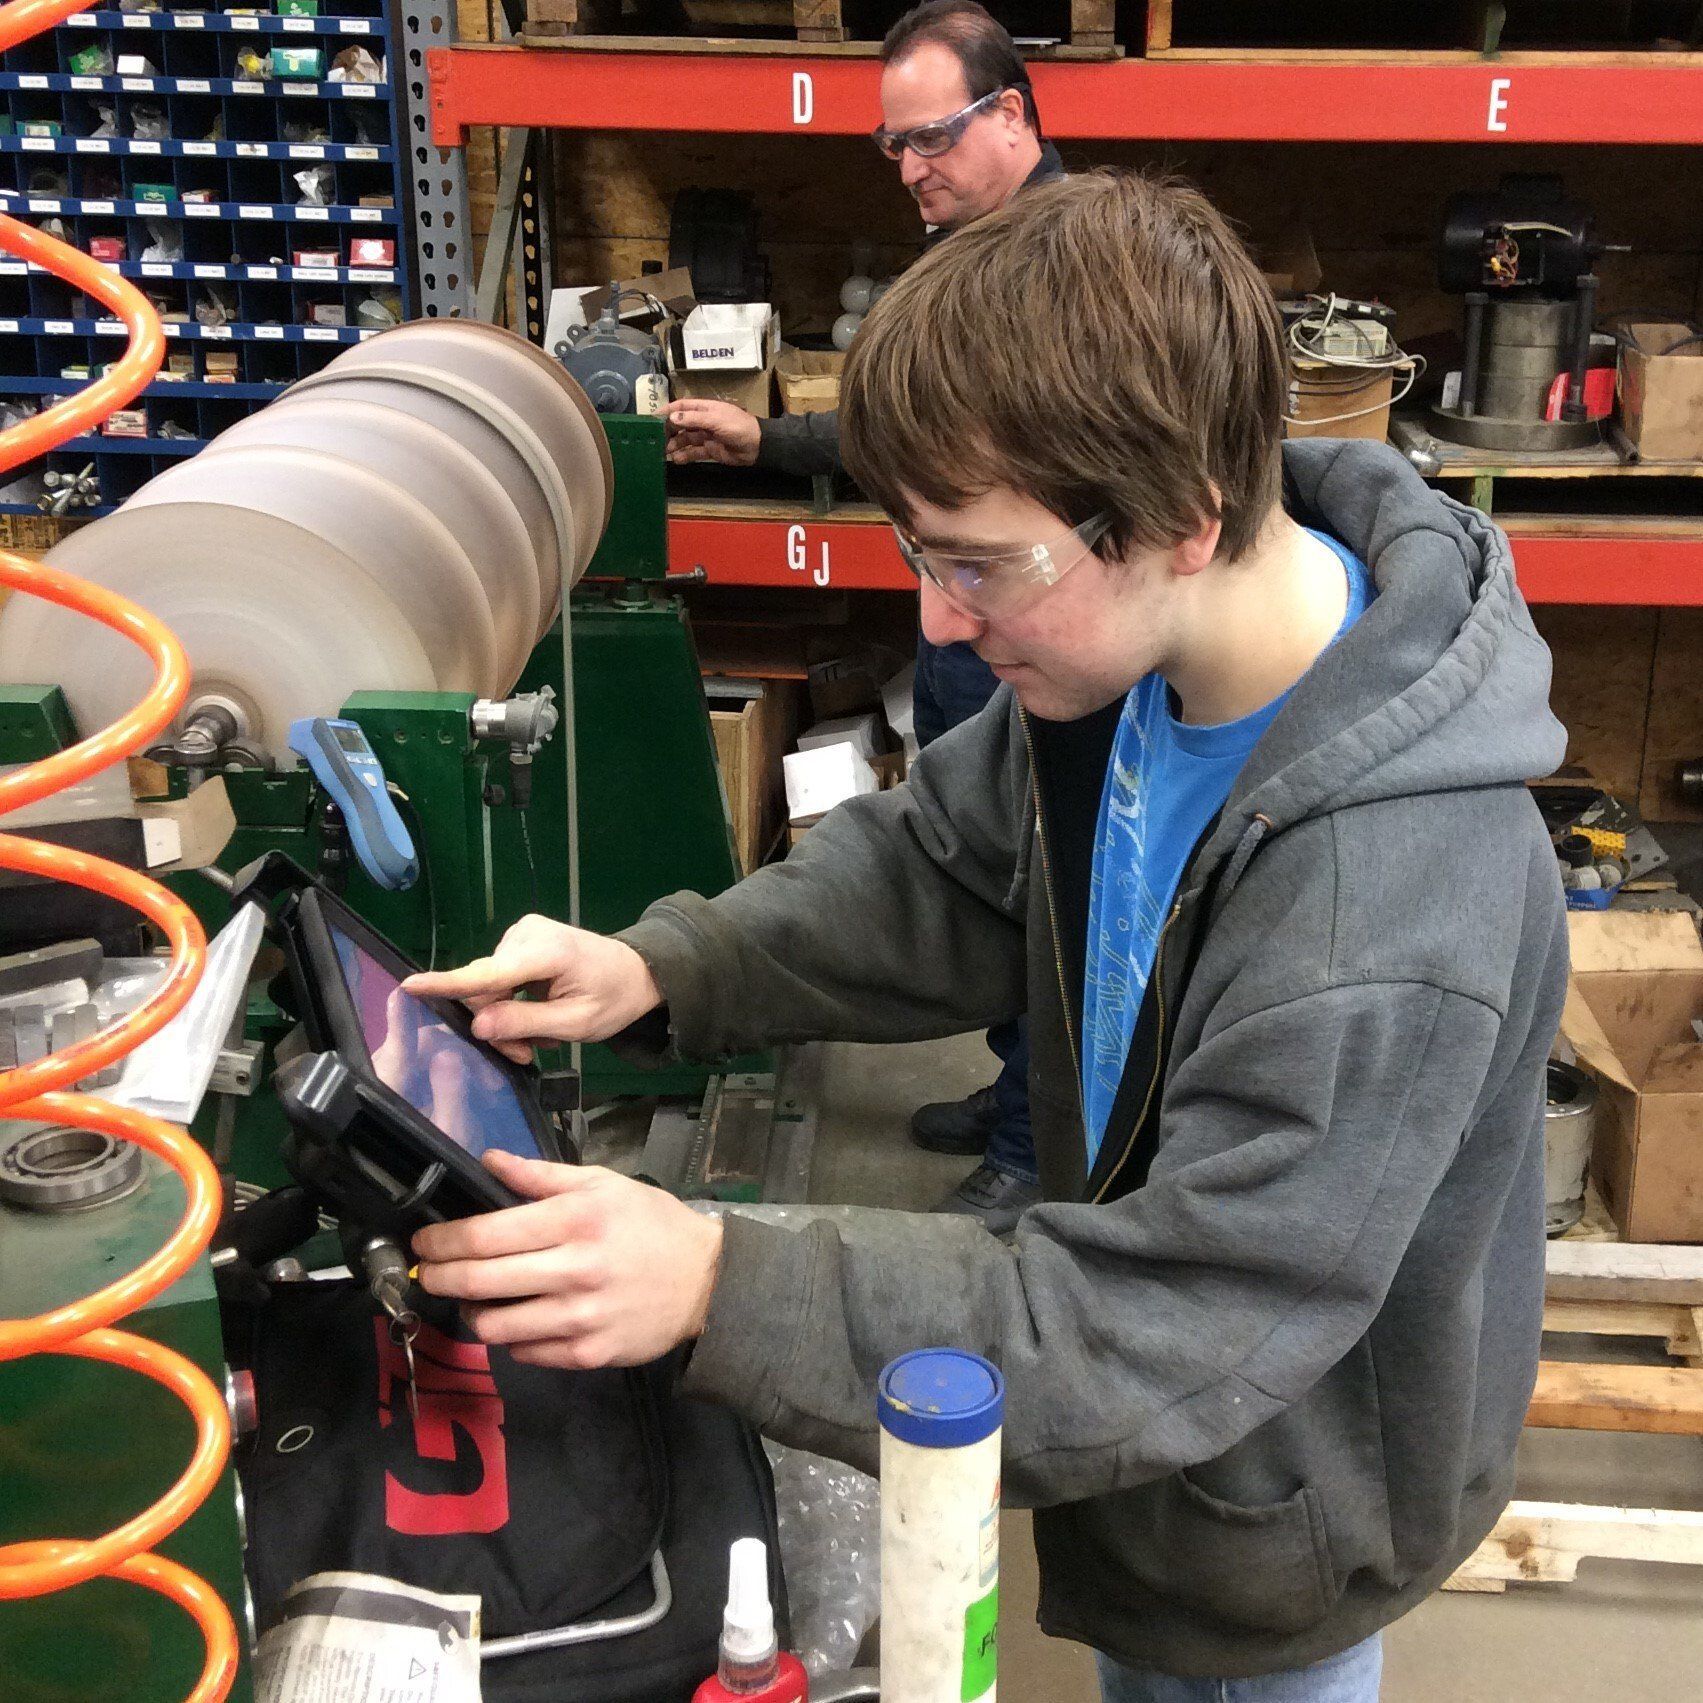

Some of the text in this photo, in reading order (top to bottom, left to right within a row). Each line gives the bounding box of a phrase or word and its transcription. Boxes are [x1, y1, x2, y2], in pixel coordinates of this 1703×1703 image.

[793, 72, 813, 124] D
[1487, 78, 1511, 132] E
[692, 347, 734, 359] BELDEN
[788, 524, 806, 570] G
[813, 541, 830, 587] J
